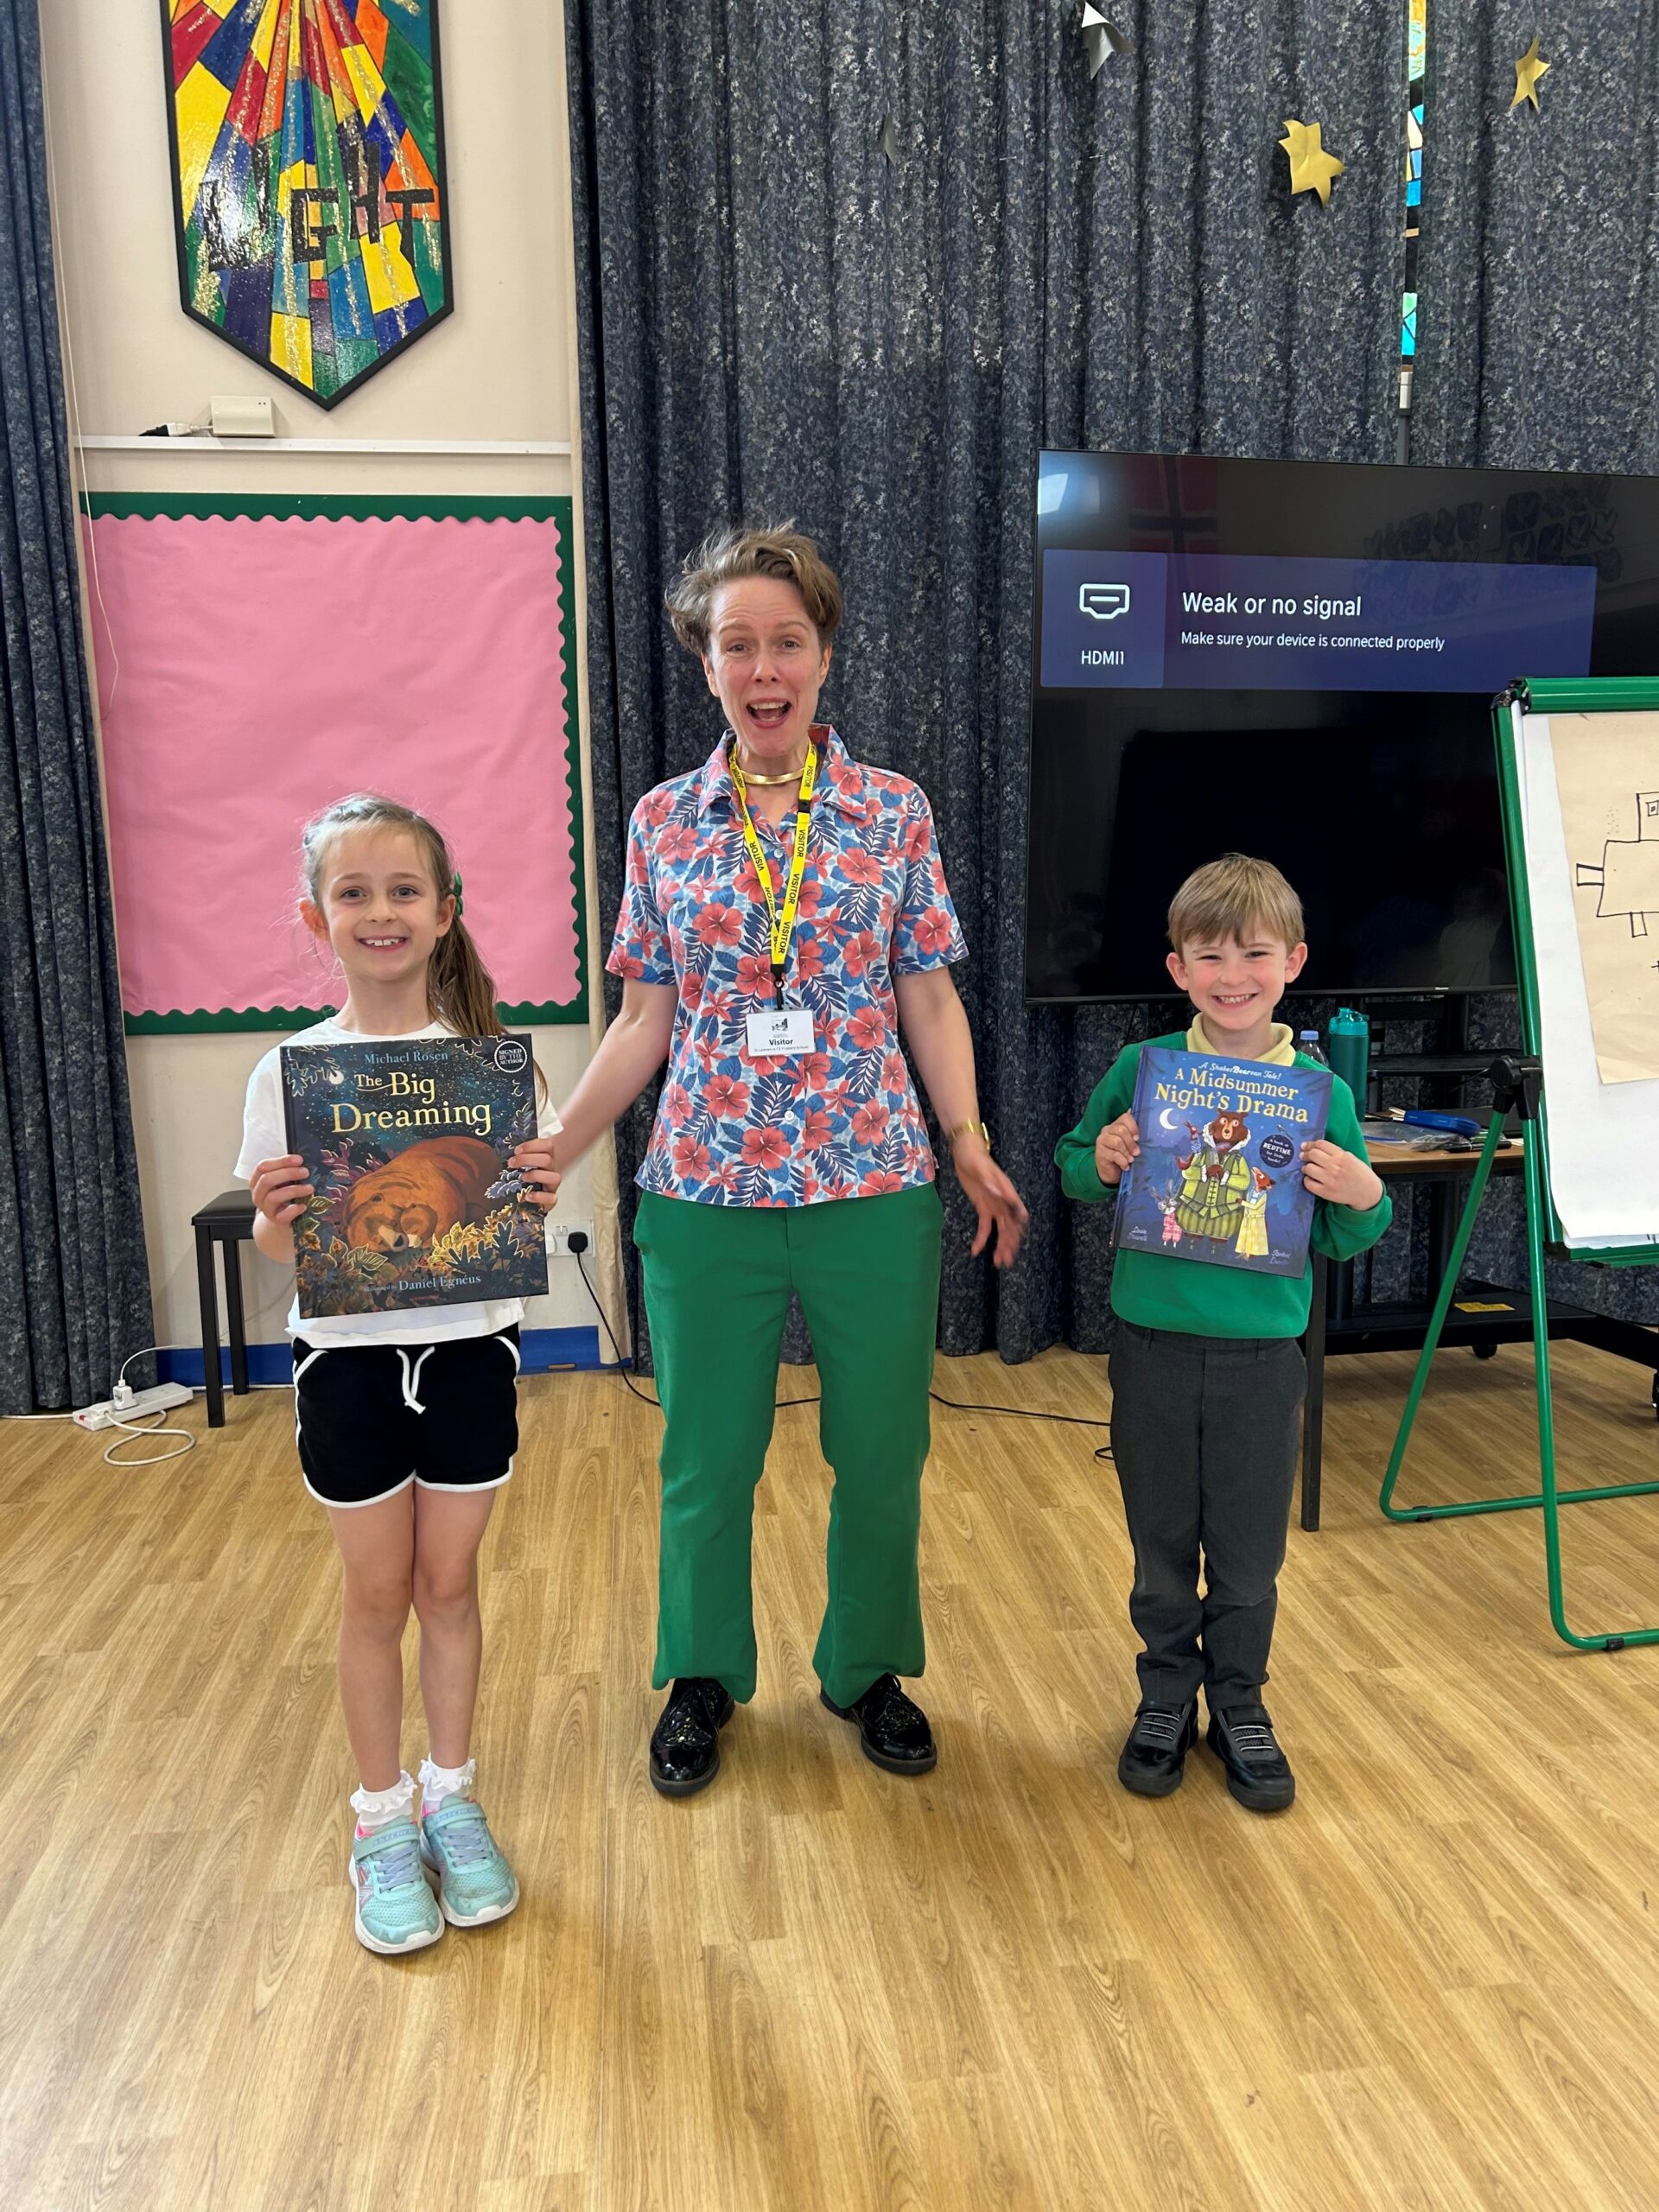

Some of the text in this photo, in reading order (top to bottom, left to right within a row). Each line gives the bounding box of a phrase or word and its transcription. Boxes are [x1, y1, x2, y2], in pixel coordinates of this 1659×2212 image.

[1182, 592, 1362, 620] Weak or no signal
[1181, 632, 1446, 652] Make sure your device is connected properly
[1081, 650, 1124, 665] HDMI1
[803, 766, 814, 788] VISITOR
[749, 842, 765, 871] VISITOR
[797, 829, 805, 857] VISITOR
[789, 874, 801, 905] VISITOR
[779, 921, 791, 954] VISITOR
[364, 1050, 448, 1065] Michael Rosen
[354, 1071, 435, 1104] The Big
[1175, 1067, 1300, 1101] A Midsummer
[1263, 1071, 1282, 1080] Tale!
[1154, 1083, 1308, 1122] Night's Drama
[330, 1101, 492, 1136] Dreaming
[1262, 1141, 1292, 1155] BEDTIME
[398, 1278, 436, 1291] Daniel
